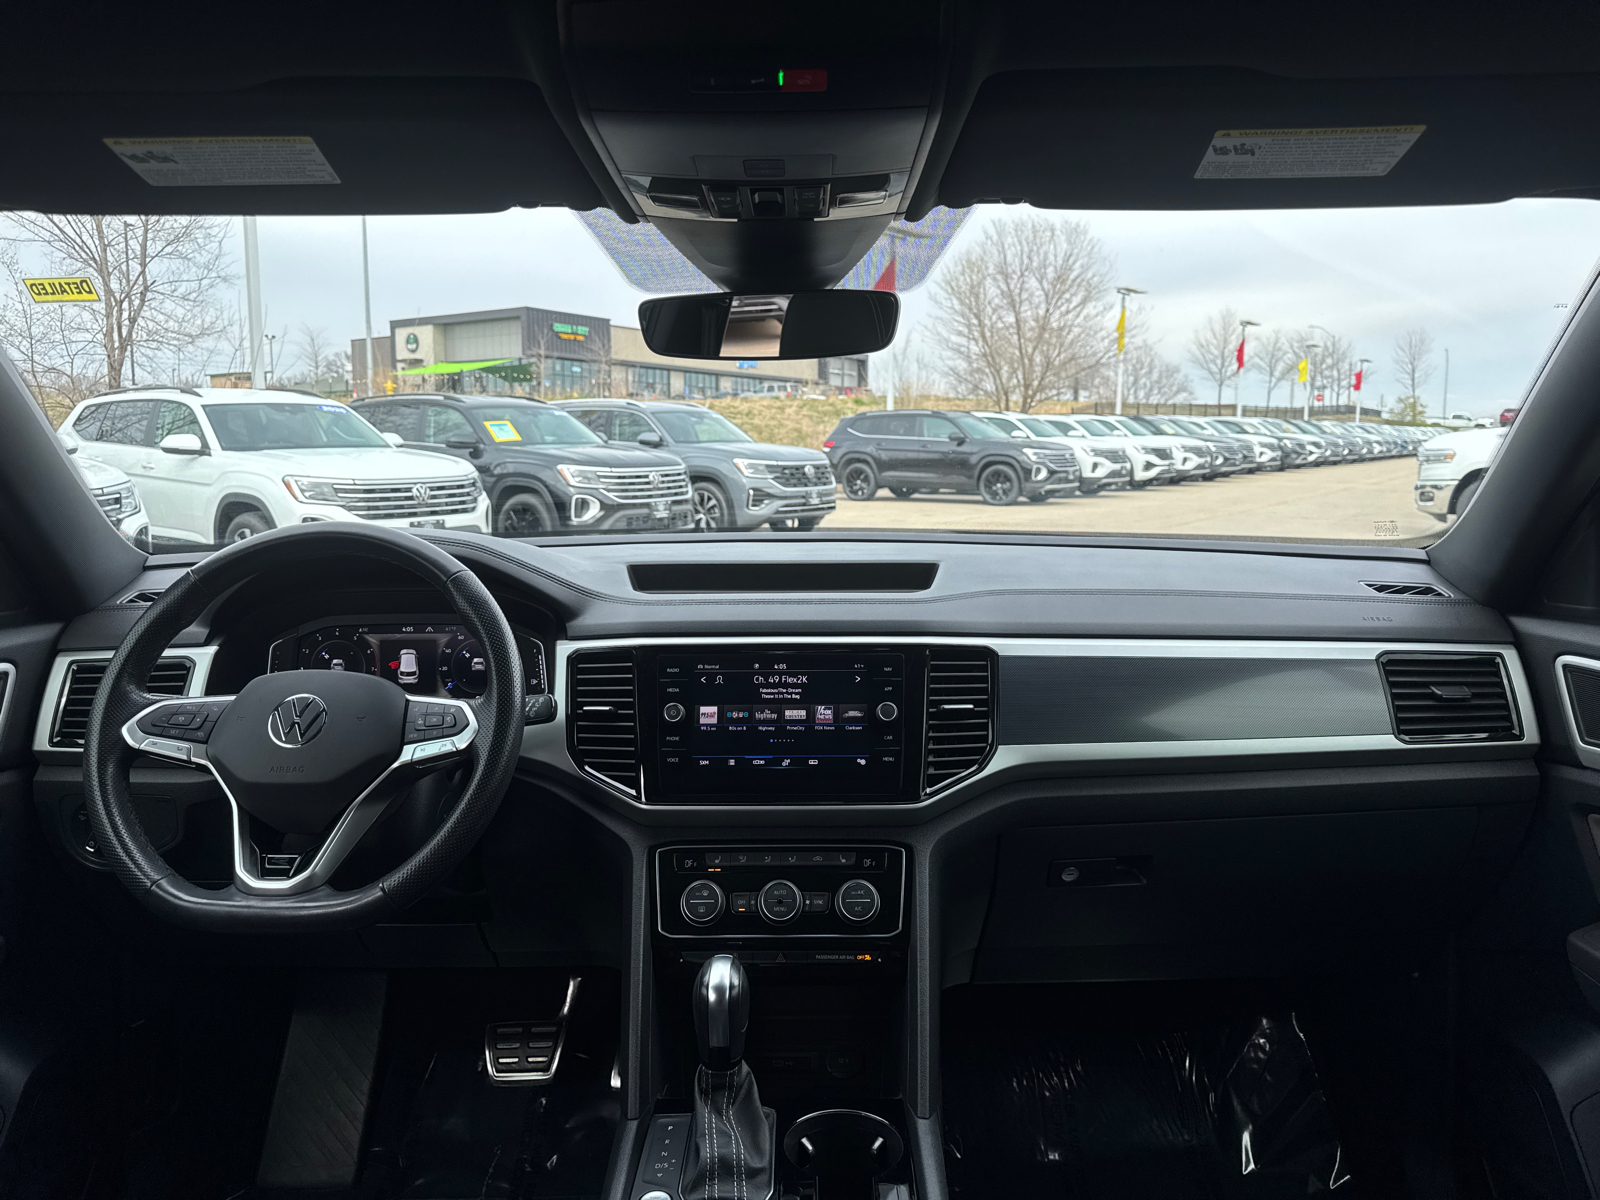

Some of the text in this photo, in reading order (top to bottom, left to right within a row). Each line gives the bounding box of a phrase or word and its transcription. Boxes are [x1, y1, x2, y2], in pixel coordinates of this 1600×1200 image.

[1306, 127, 1415, 135] AVERTISSEMENT!
[753, 675, 808, 684] Ch. 49 Flex2K
[755, 711, 778, 720] highway
[268, 766, 305, 774] AIRBAG
